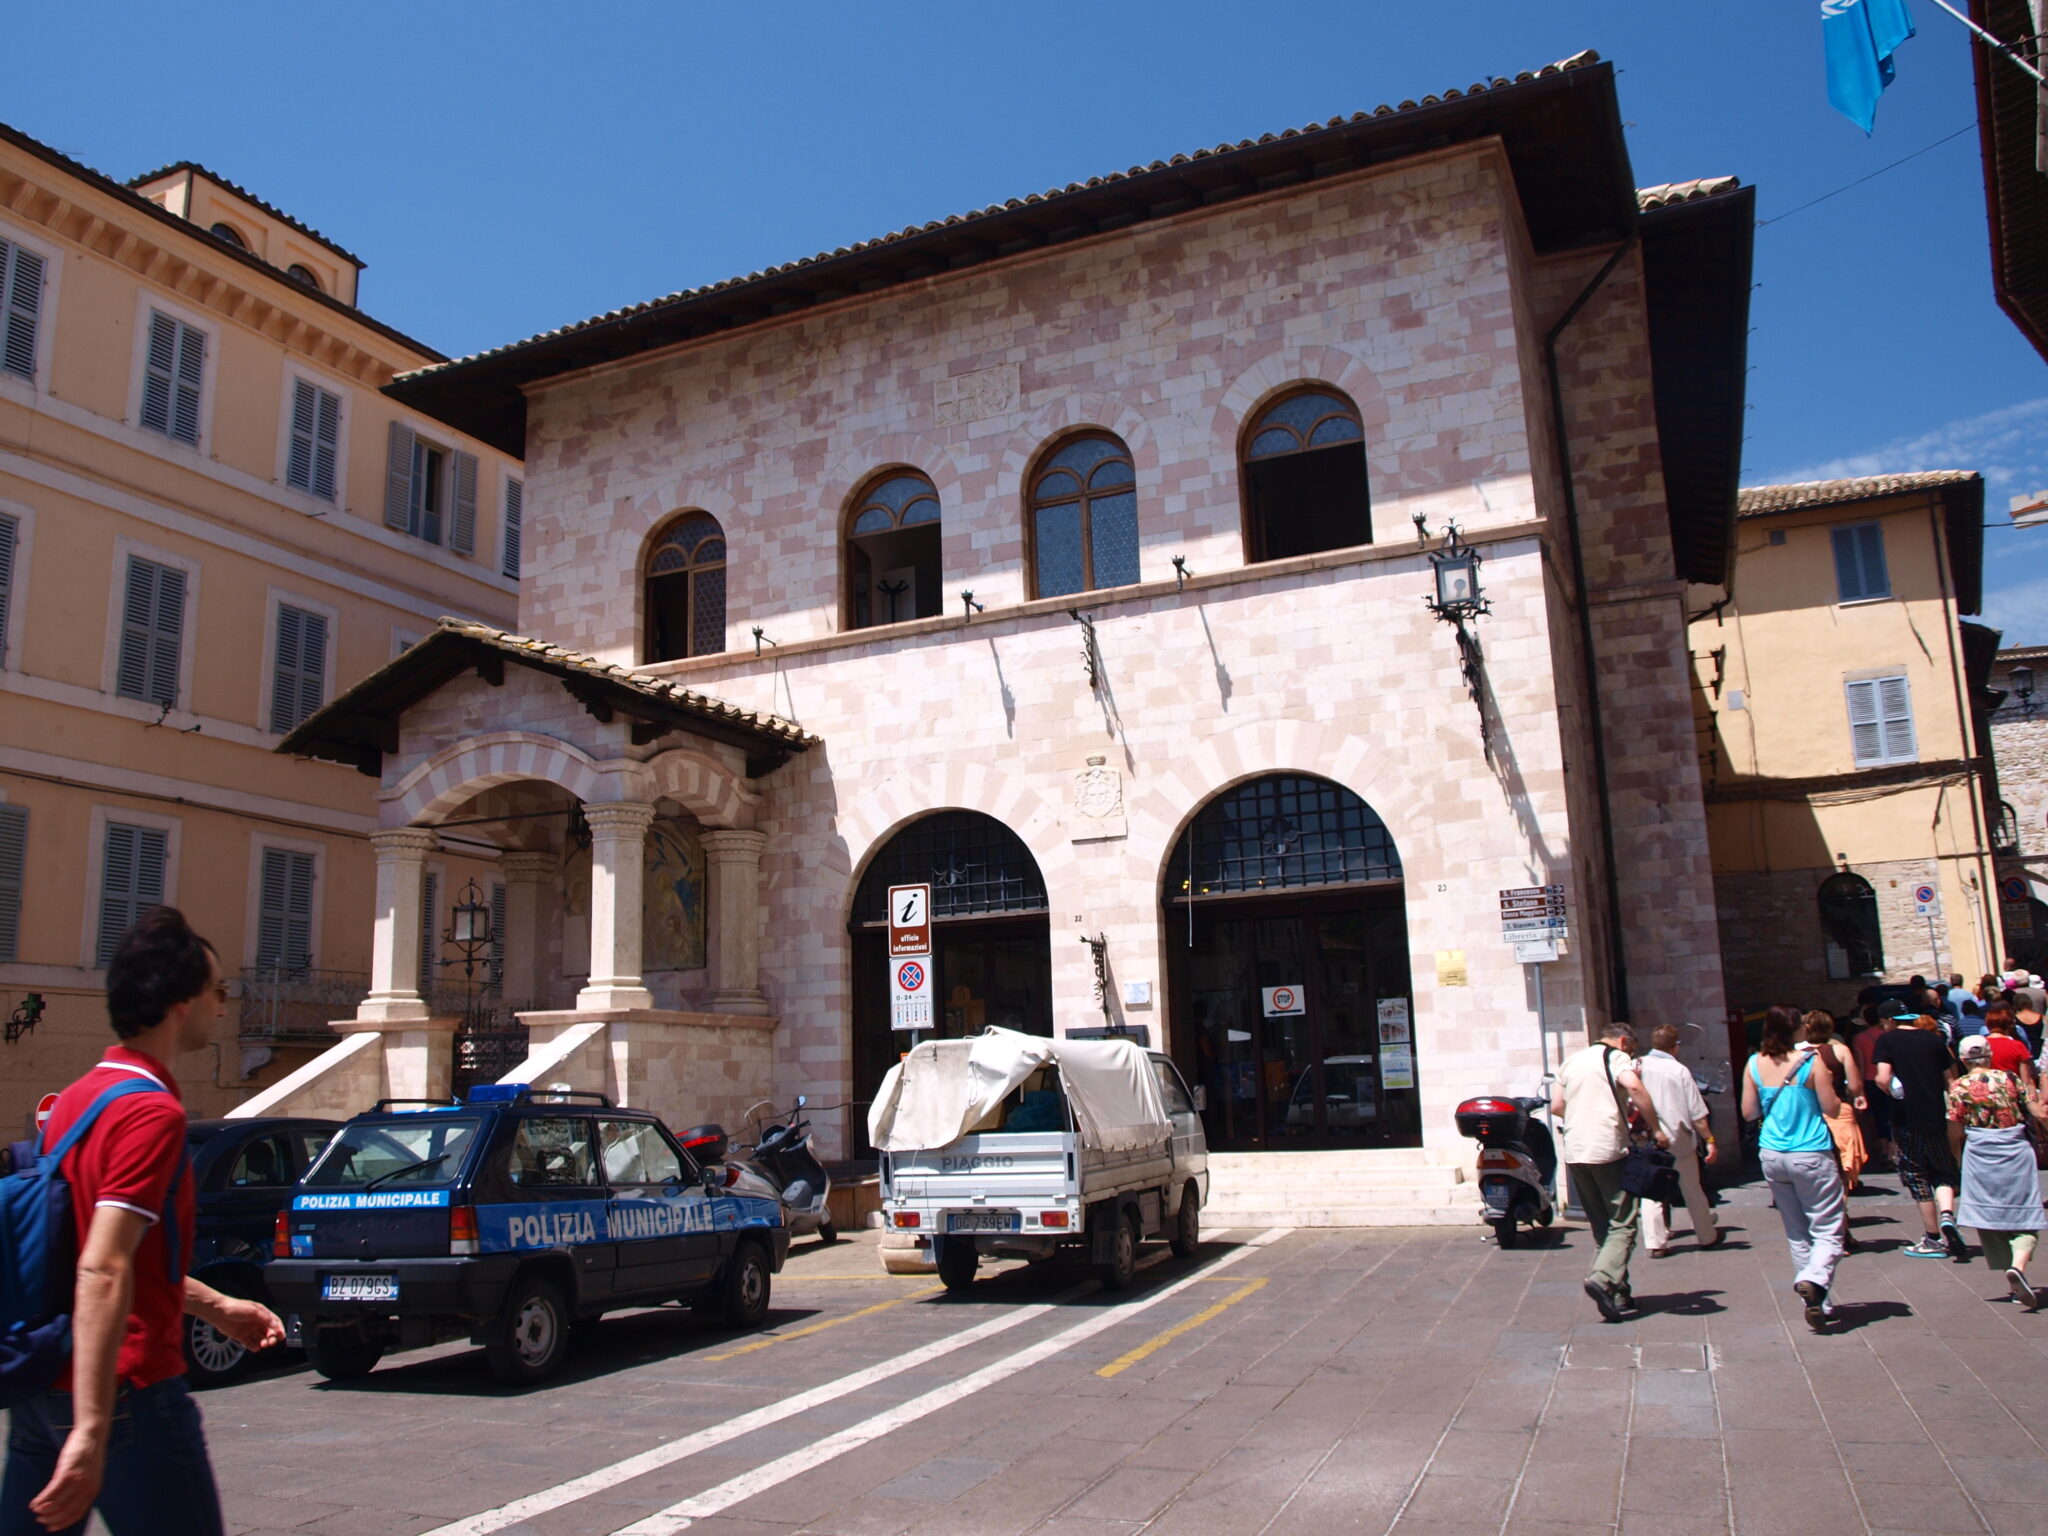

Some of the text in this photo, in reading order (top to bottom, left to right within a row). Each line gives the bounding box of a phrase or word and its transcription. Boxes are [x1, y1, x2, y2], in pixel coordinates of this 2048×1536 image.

[1511, 888, 1540, 897] Francesco
[900, 893, 918, 923] i
[1512, 898, 1539, 908] Stefano
[1520, 909, 1545, 919] Maggiore
[900, 934, 919, 942] ufficio
[1503, 931, 1537, 941] Libreria
[893, 943, 928, 953] informazioni
[1277, 994, 1291, 1004] STOP
[941, 1155, 1015, 1170] PIAGGIO
[301, 1192, 441, 1209] POLIZIA MUNICIPALE
[508, 1203, 715, 1248] POLIZIA MUNICIPALE
[331, 1277, 346, 1295] BZ
[350, 1276, 390, 1295] 079GS
